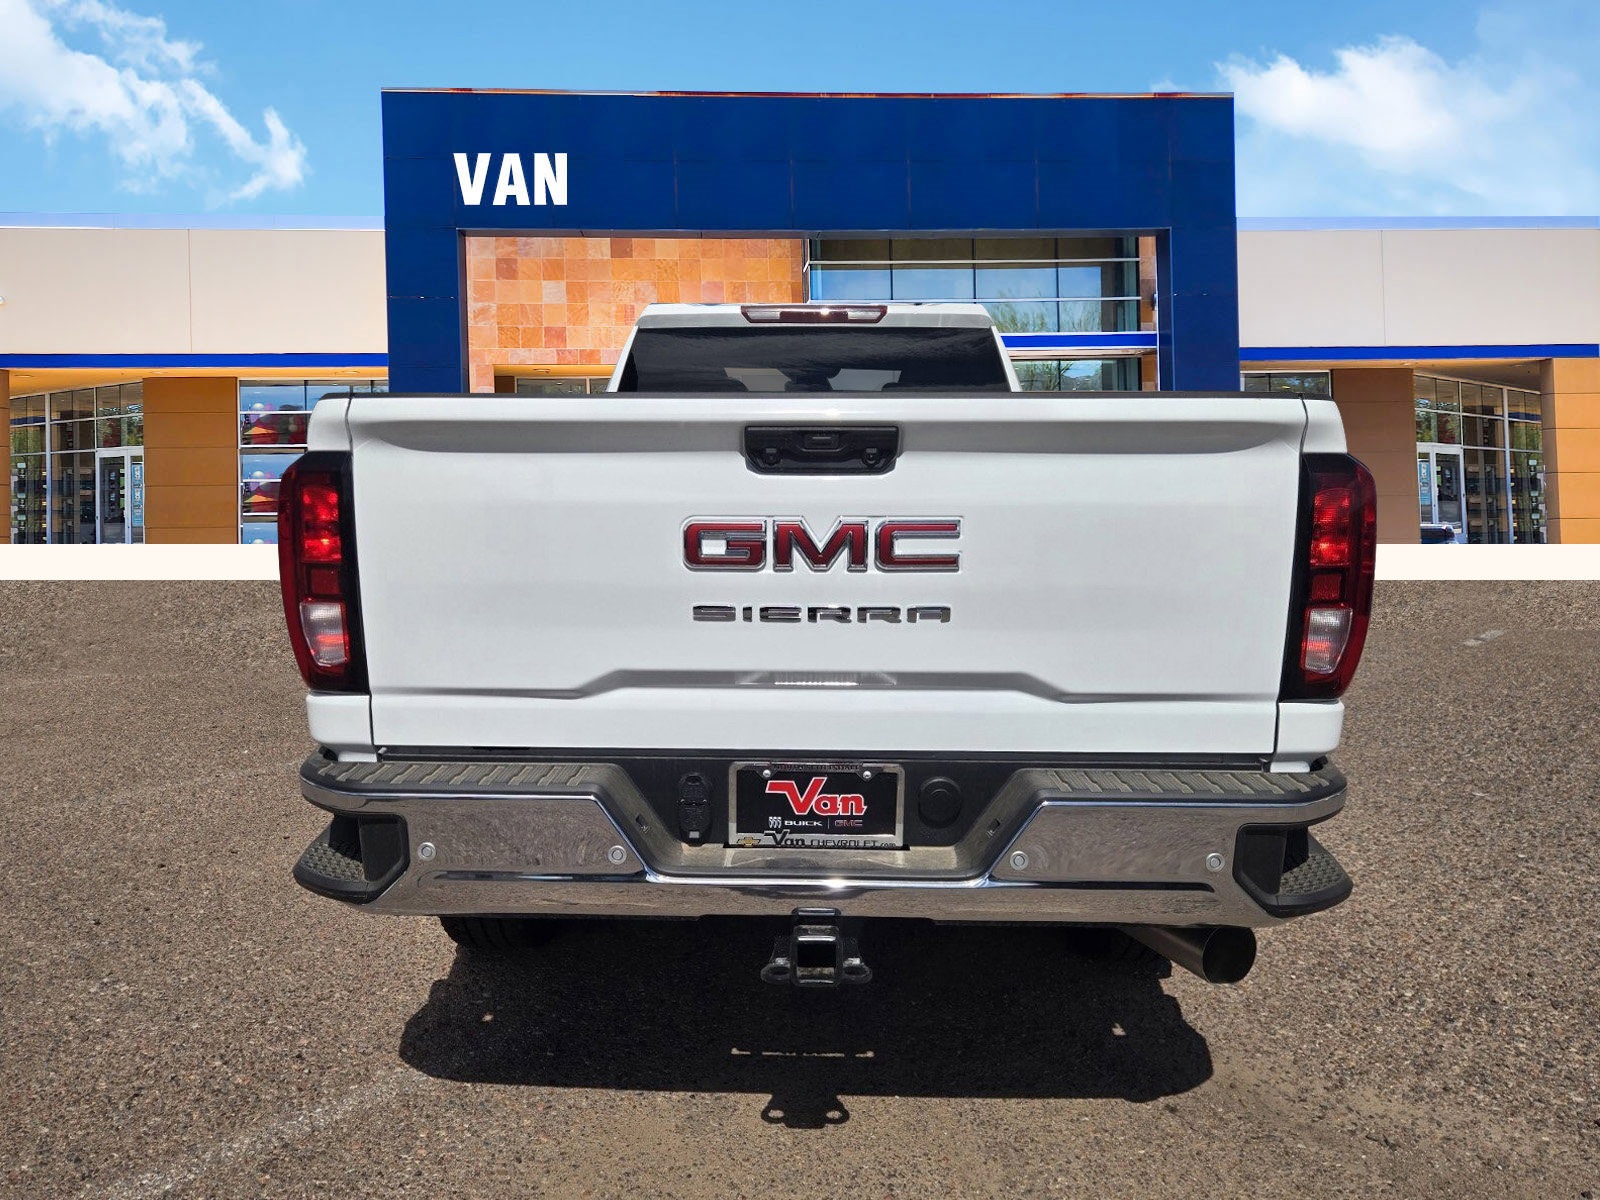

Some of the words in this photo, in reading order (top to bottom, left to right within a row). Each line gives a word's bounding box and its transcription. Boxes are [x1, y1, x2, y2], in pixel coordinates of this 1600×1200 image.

[453, 153, 568, 206] VAN
[681, 515, 962, 572] GMC
[692, 605, 952, 623] SIERRA
[765, 777, 867, 816] Van
[835, 819, 863, 827] GMC
[764, 829, 806, 847] Van
